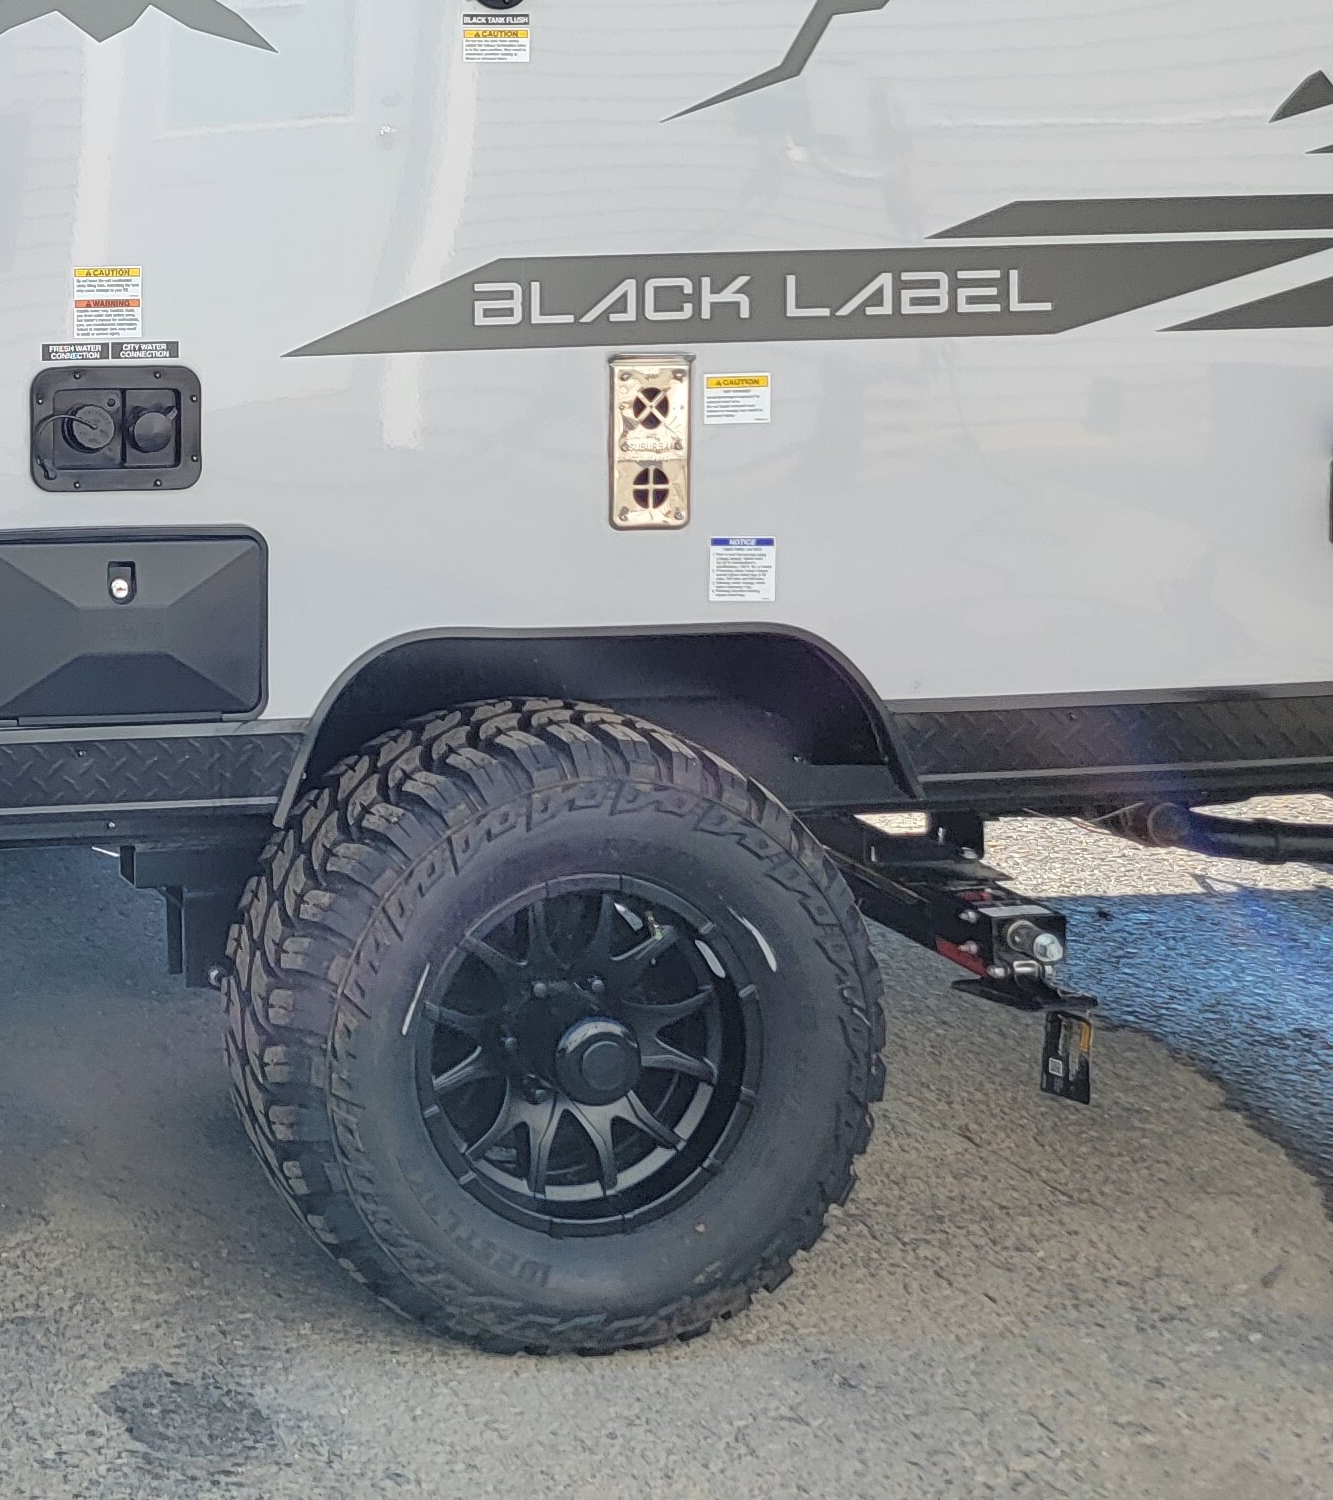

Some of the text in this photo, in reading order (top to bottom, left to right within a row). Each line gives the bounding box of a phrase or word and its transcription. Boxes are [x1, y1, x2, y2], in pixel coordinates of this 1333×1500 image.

[463, 16, 528, 24] BLACK TANK FLUSH
[482, 30, 519, 38] CAUTION
[92, 268, 130, 276] CAUTION
[473, 268, 1053, 327] BLACK LABEL
[92, 299, 130, 307] WARNING
[76, 344, 101, 352] WATER
[122, 343, 139, 351] CITY
[50, 351, 100, 360] CONNECTION
[120, 350, 169, 358] CONNECTION
[721, 378, 760, 387] CAUTION
[728, 538, 757, 546] NOTICE
